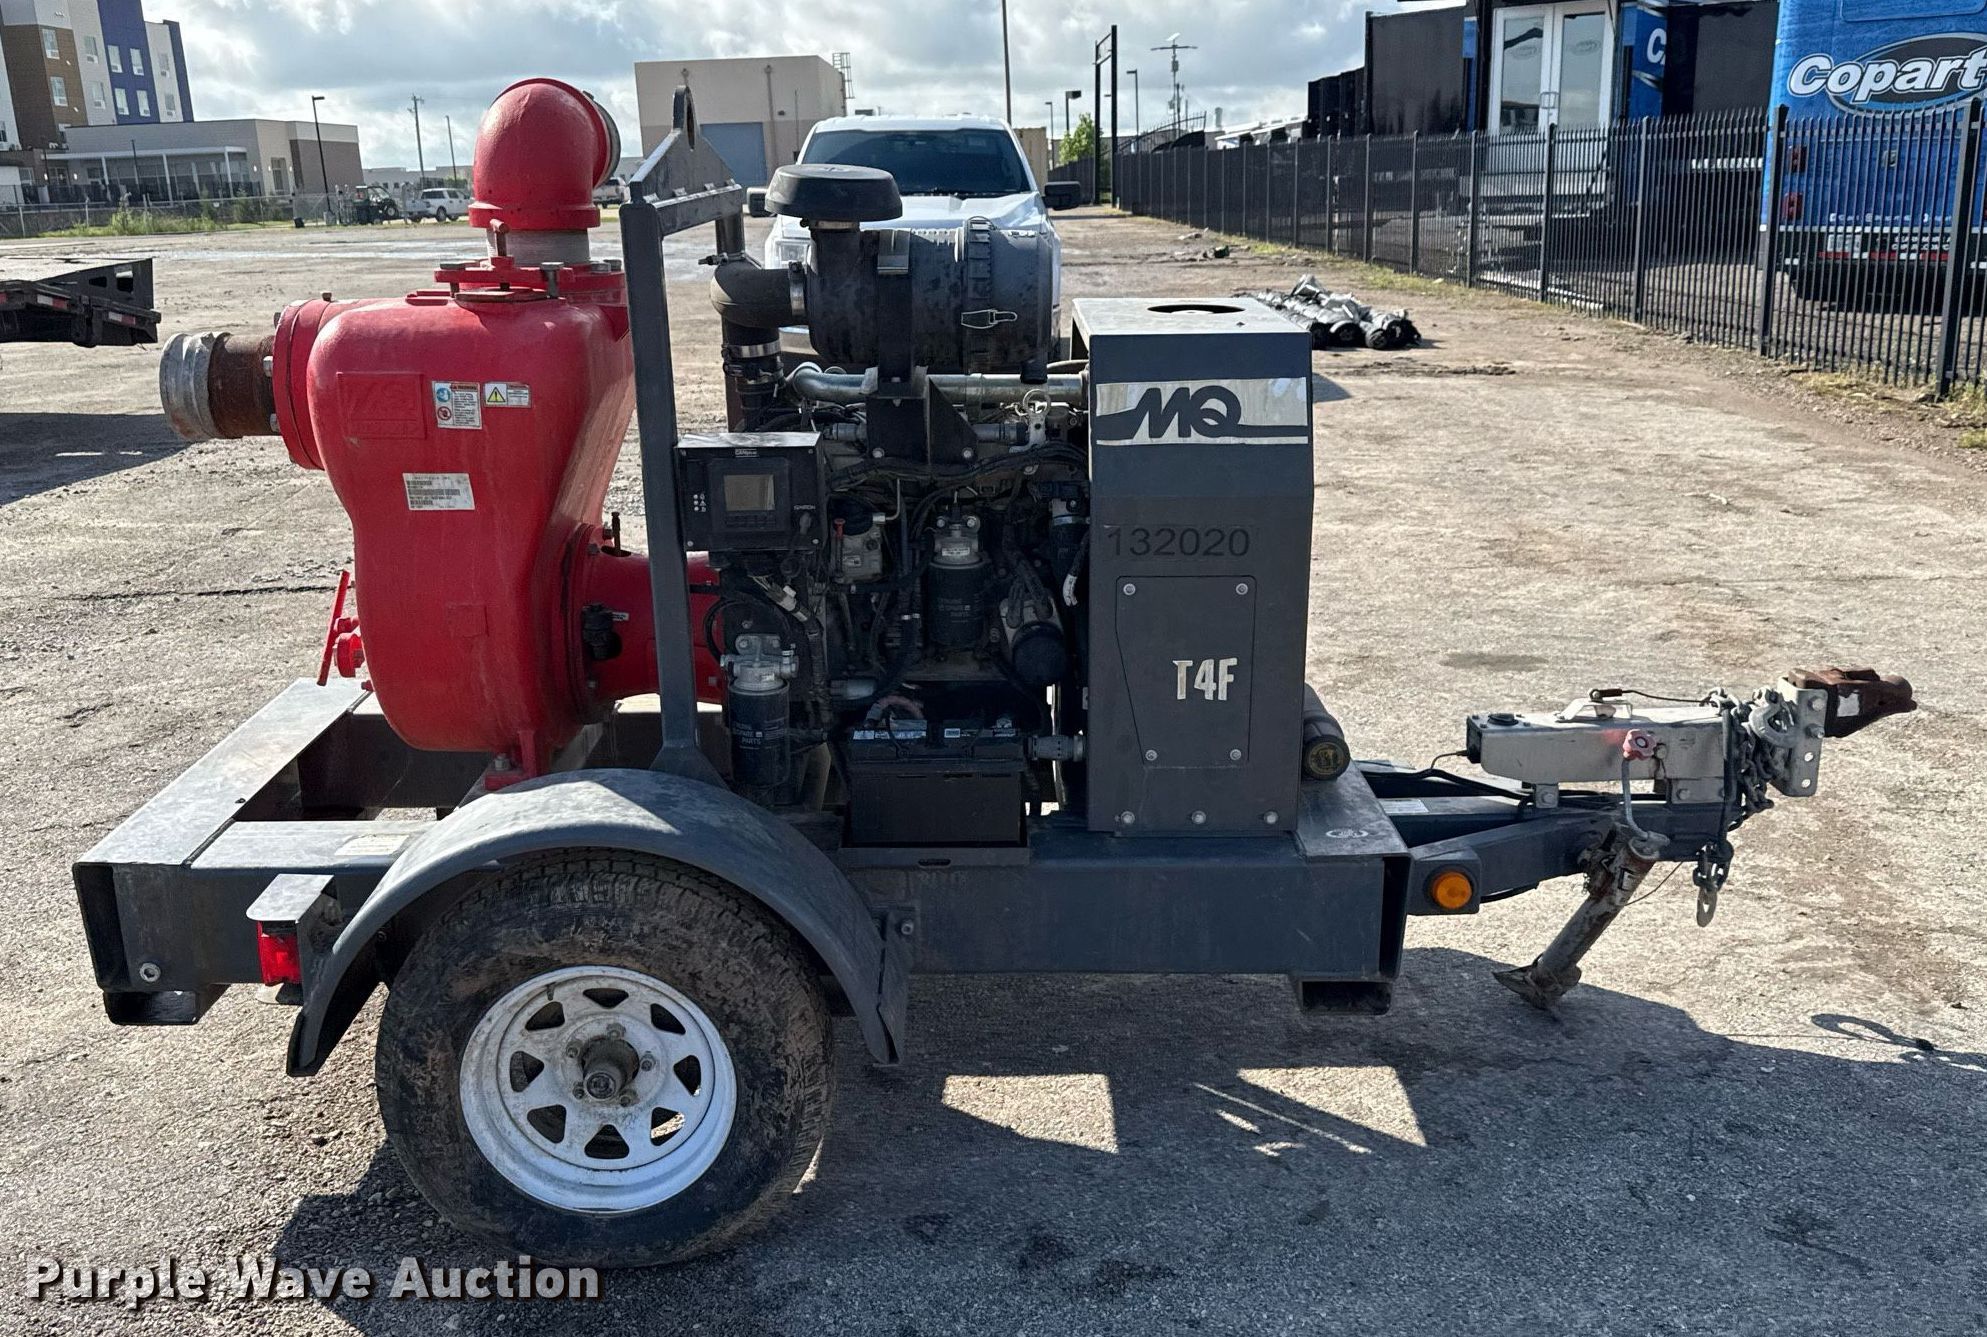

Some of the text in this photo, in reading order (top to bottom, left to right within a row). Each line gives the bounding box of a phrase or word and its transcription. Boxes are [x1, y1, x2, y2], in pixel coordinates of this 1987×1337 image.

[1788, 47, 1987, 103] Copart
[1131, 384, 1242, 438] MQ
[1107, 527, 1250, 557] 132020
[1172, 657, 1238, 701] T4F
